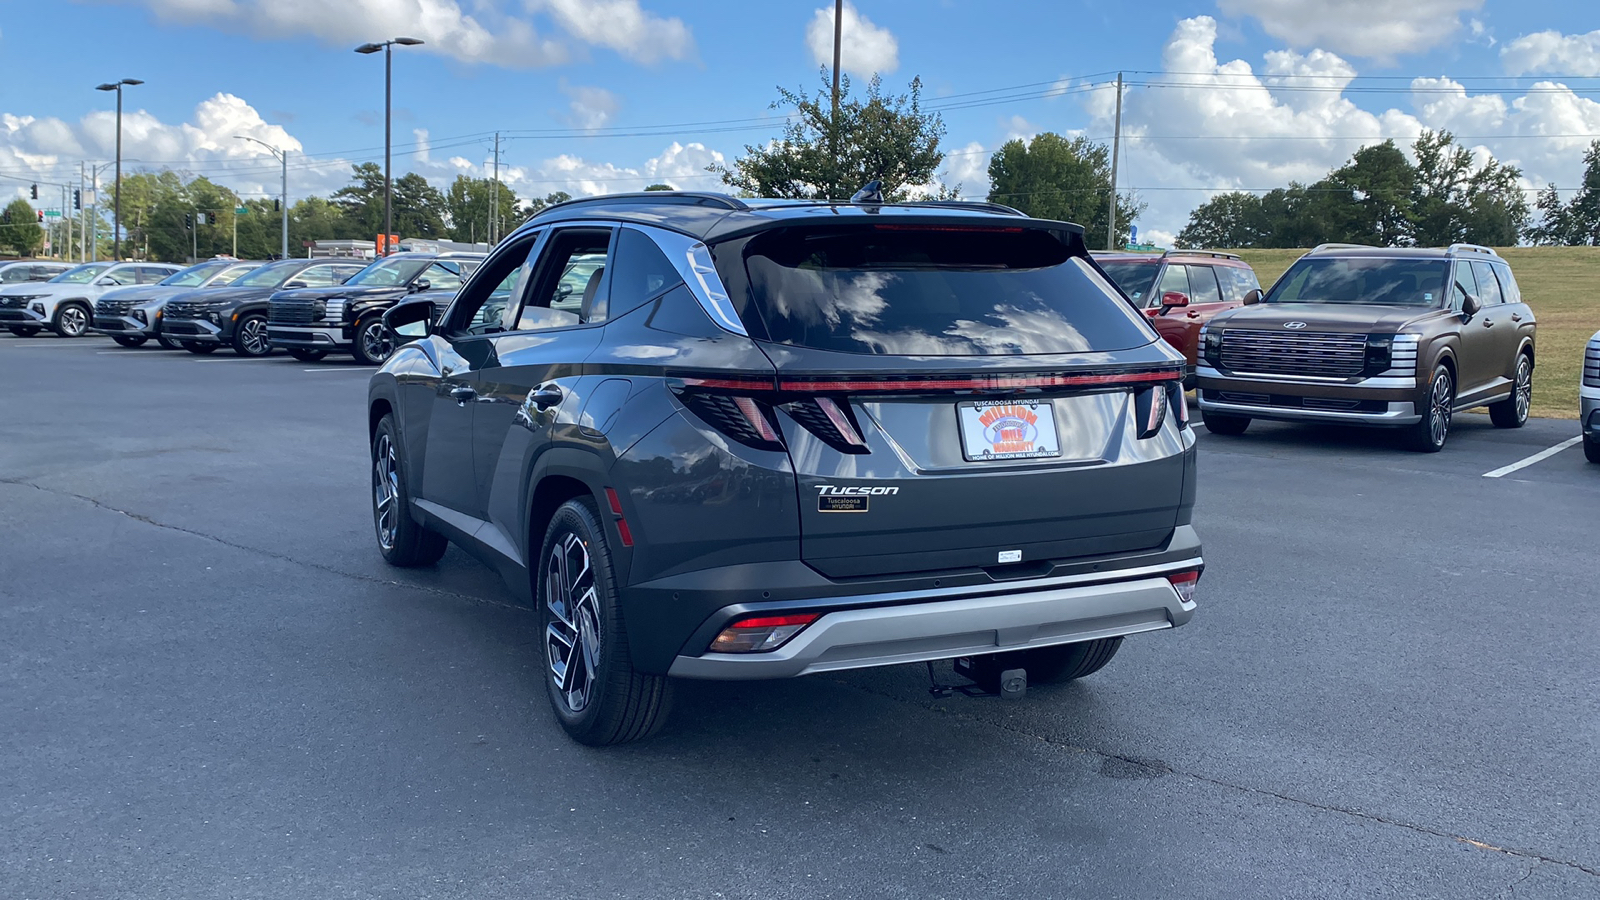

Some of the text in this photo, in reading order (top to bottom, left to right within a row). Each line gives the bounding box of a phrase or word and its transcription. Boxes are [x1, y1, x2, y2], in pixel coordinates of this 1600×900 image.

[979, 405, 1038, 428] MILLION
[1001, 428, 1023, 441] MILE
[993, 441, 1034, 453] WARRANTY
